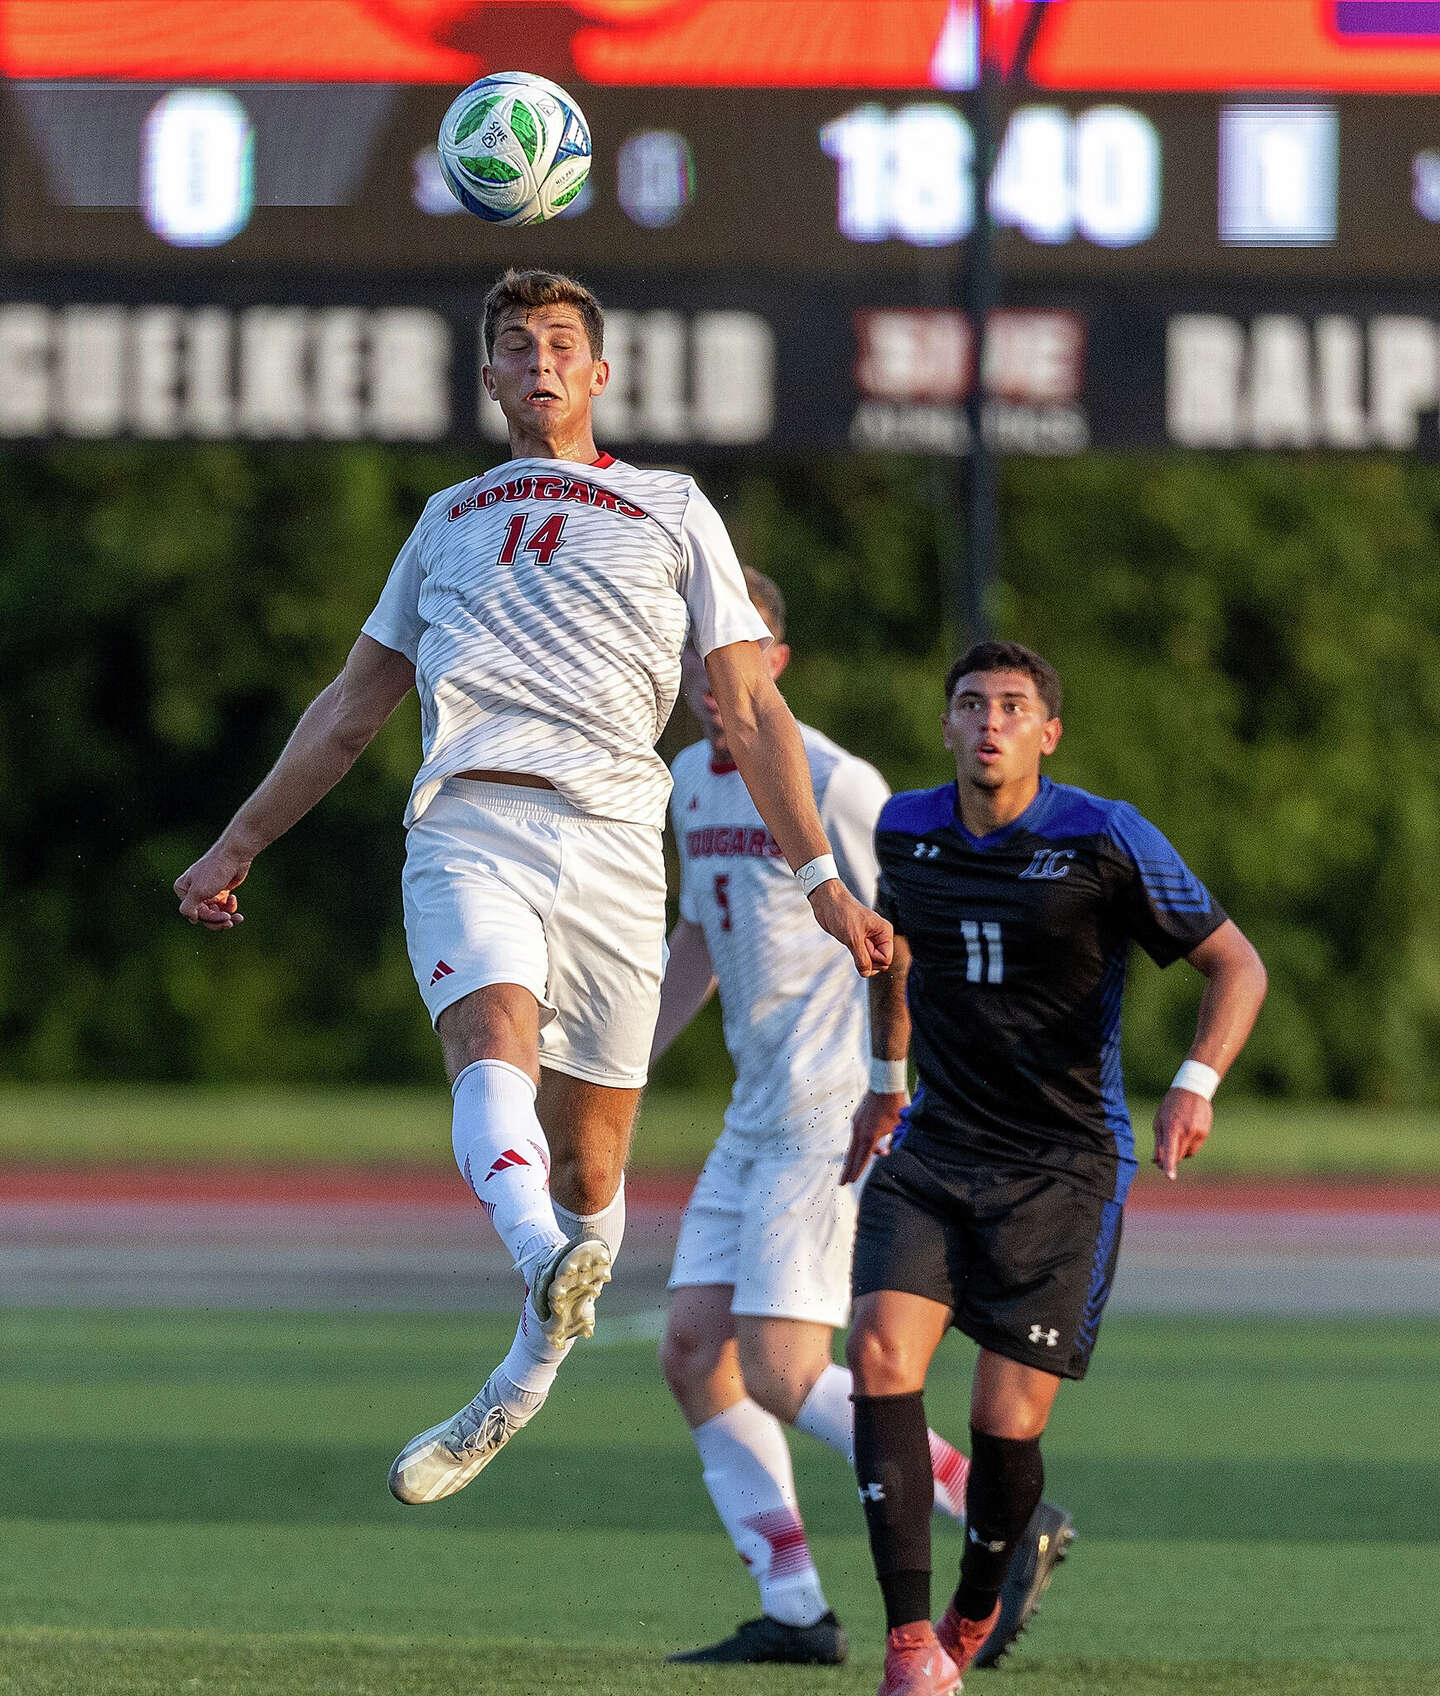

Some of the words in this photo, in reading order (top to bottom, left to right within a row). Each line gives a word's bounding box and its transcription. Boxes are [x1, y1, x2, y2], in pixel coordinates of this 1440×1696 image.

[143, 90, 252, 246] 0
[447, 474, 650, 522] COUGARS
[497, 512, 568, 566] 14
[960, 920, 1004, 984] 11
